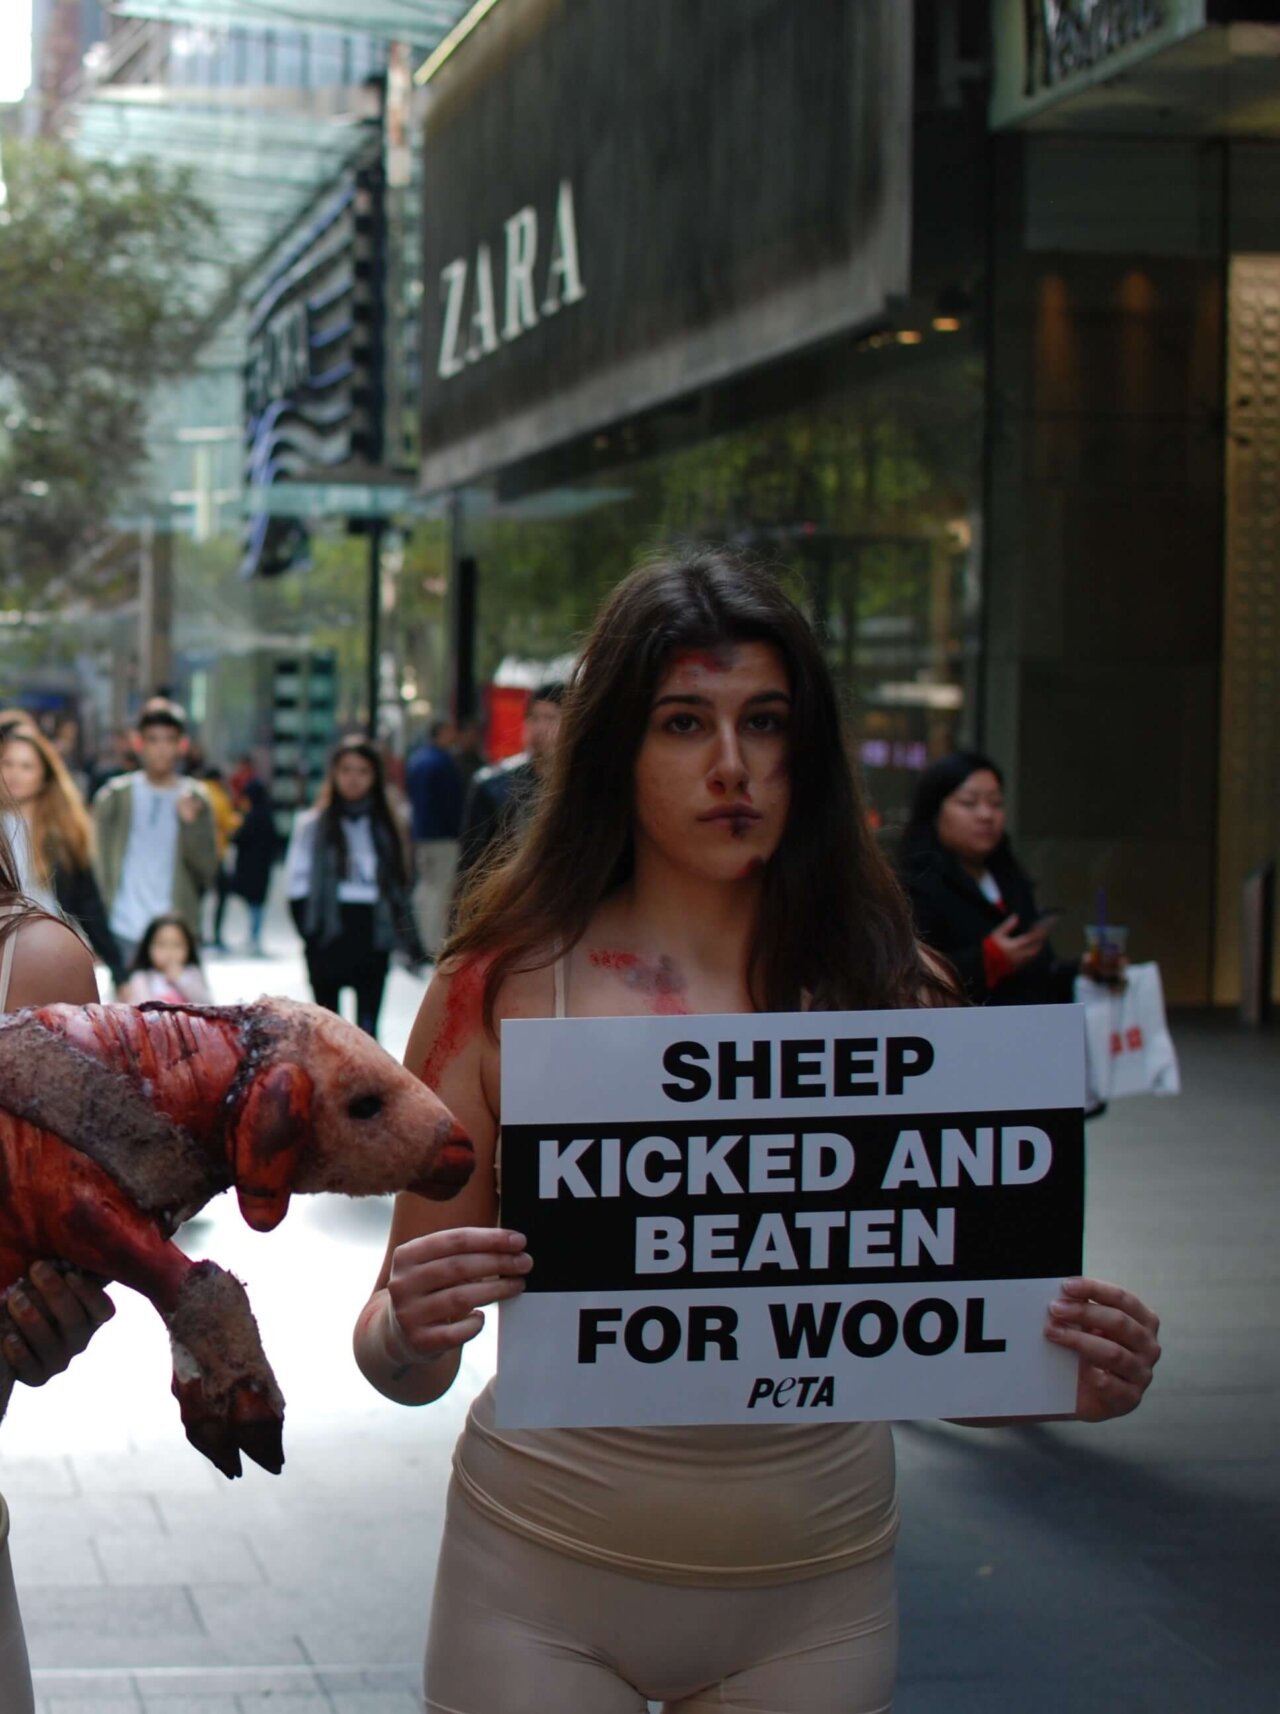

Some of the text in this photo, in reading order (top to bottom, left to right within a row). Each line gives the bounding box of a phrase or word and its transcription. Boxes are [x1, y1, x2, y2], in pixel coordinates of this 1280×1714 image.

[438, 179, 586, 379] ZARA
[662, 1036, 935, 1103] SHEEP
[538, 1125, 1053, 1199] KICKED AND
[634, 1207, 957, 1275] BEATEN
[577, 1297, 1007, 1364] FOR WOOL
